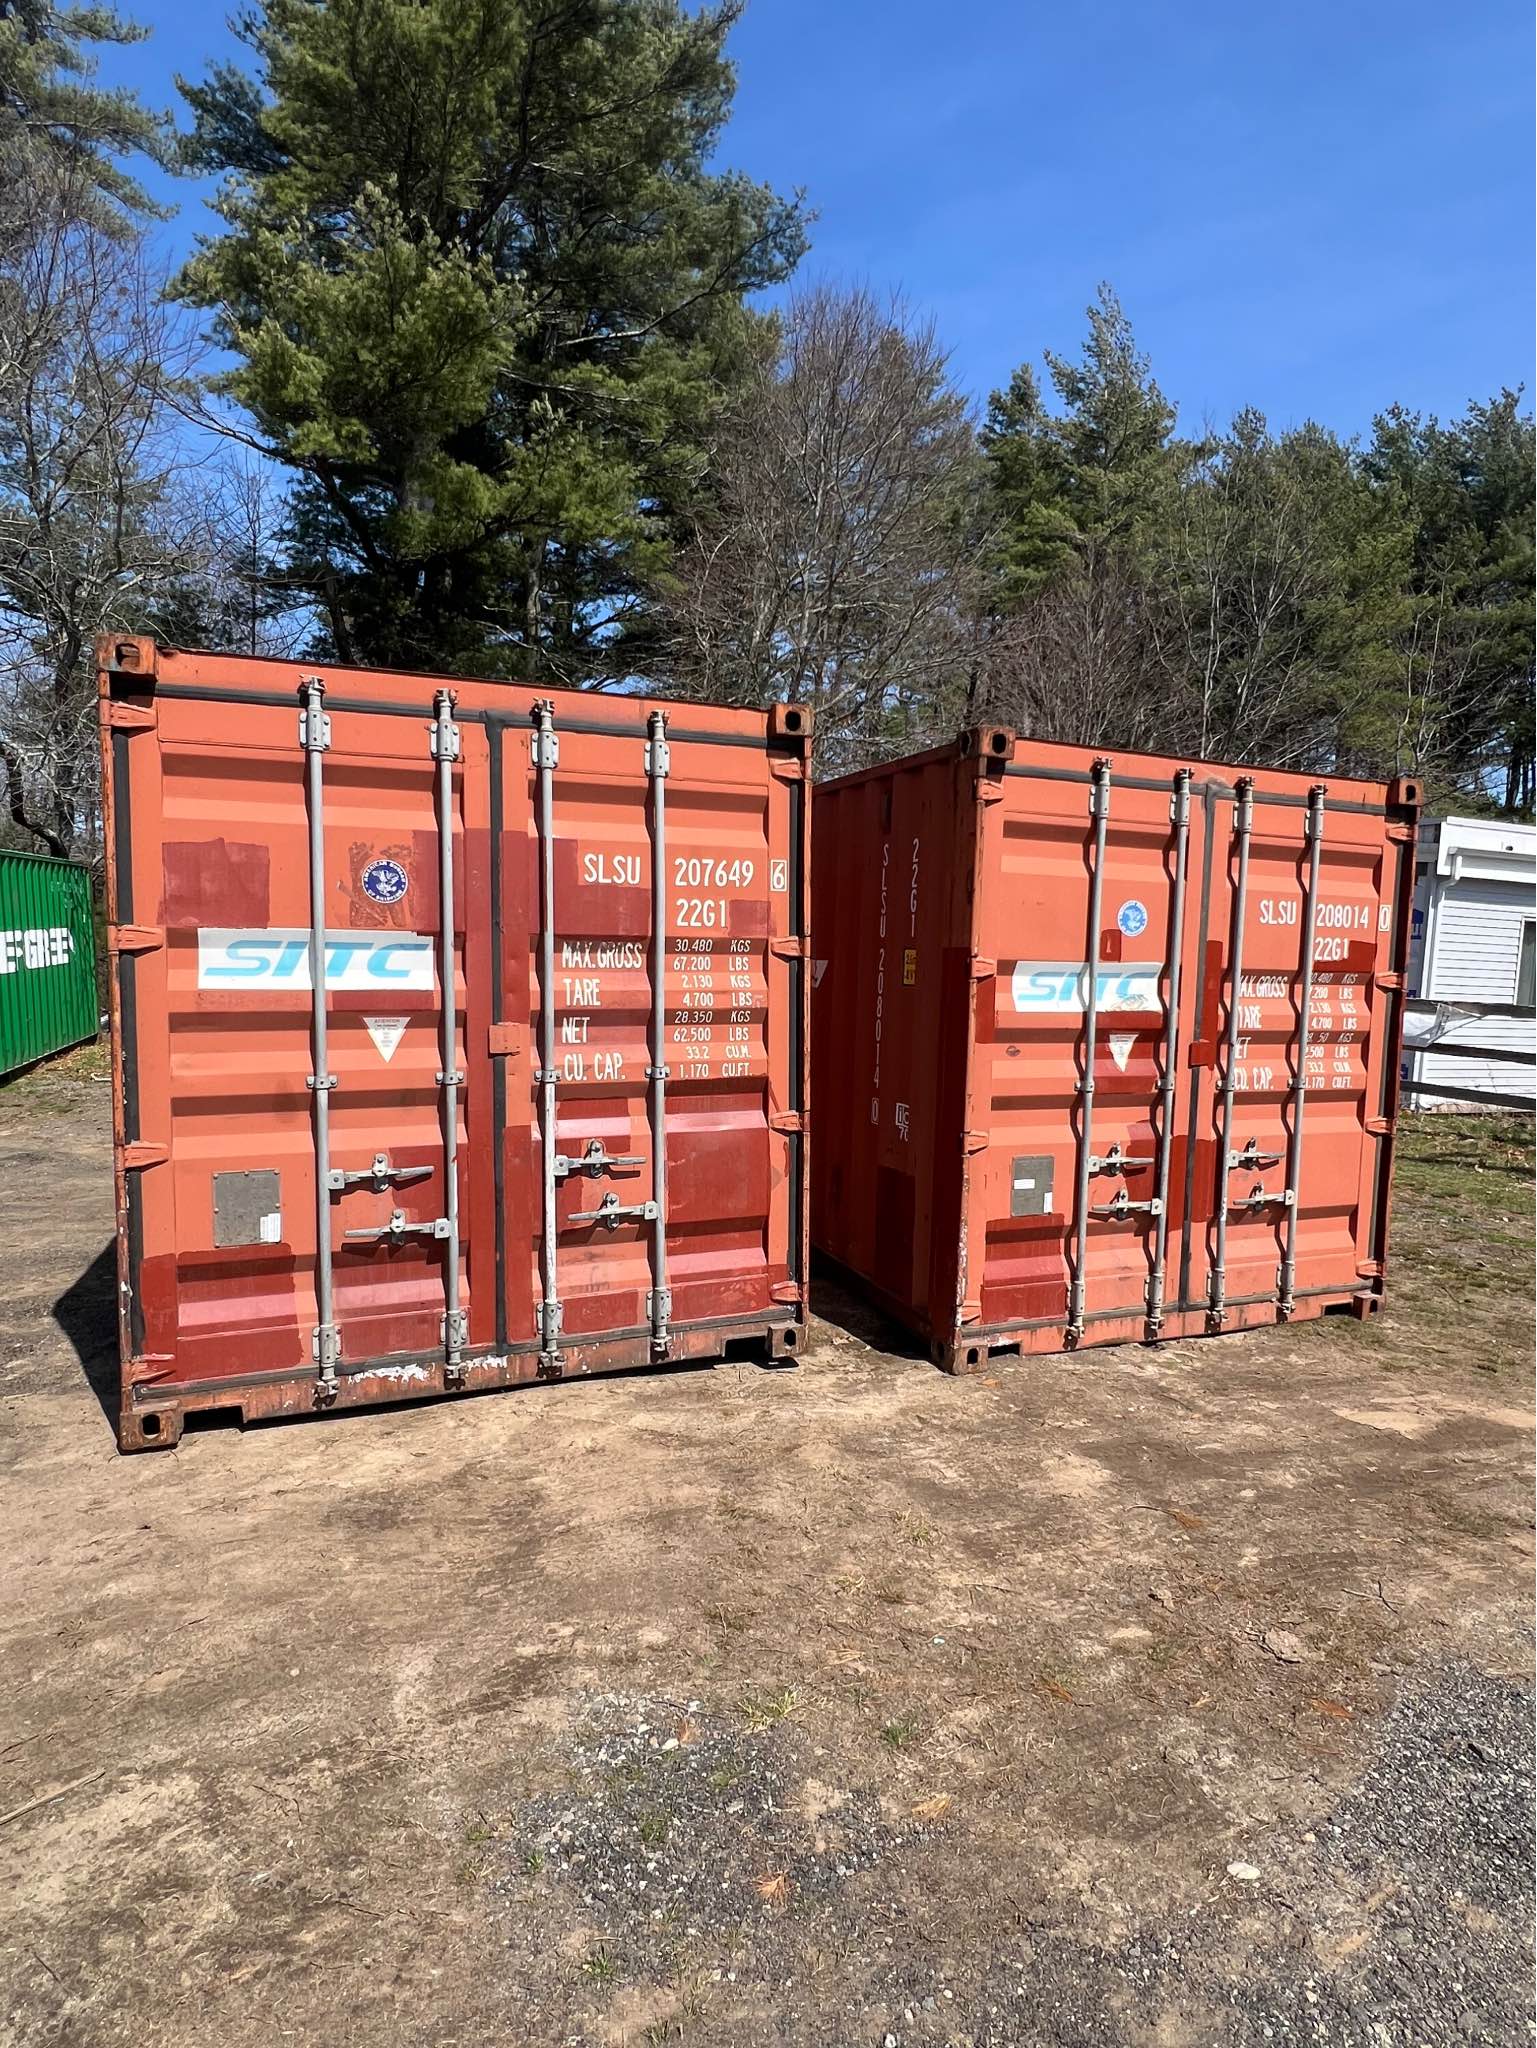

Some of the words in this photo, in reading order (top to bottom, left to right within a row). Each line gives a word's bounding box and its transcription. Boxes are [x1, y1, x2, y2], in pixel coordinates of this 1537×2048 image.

[583, 854, 641, 885] SLSU
[674, 858, 754, 887] 207649
[771, 861, 786, 890] 6
[880, 843, 889, 938] SLSU
[910, 838, 919, 938] 22G1
[676, 899, 727, 928] 22G1
[1259, 900, 1297, 925] SLSU
[1316, 903, 1369, 929] 208014
[1380, 906, 1390, 930] 0
[675, 939, 713, 953] 30.480
[730, 939, 751, 952] KGS
[1314, 937, 1349, 961] 22G1
[204, 940, 430, 978] SITC
[673, 956, 711, 971] 67.200
[729, 956, 749, 971] LBS
[682, 975, 713, 988] 2.130
[731, 975, 751, 988] KGS
[1017, 971, 1159, 1001] SITC
[1239, 976, 1288, 998] AX.GROSS
[1311, 973, 1333, 984] 0.480
[563, 978, 600, 1006] TARE
[683, 992, 713, 1007] 4.700
[732, 992, 752, 1007] LBS
[1339, 987, 1353, 999] LBS
[675, 1011, 713, 1023] 28.350
[730, 1011, 751, 1023] KGS
[874, 948, 885, 1088] 208014
[1238, 1005, 1262, 1028] TARE
[1312, 1018, 1333, 1029] 4.700
[1343, 1018, 1357, 1029] LBS
[562, 1017, 591, 1043] NET
[673, 1028, 711, 1042] 62.500
[729, 1028, 749, 1041] LBS
[687, 1046, 710, 1059] 33.2
[1335, 1046, 1349, 1058] LBS
[564, 1054, 588, 1081] CU.
[594, 1053, 625, 1080] CAP.
[680, 1064, 709, 1079] 1.170
[1253, 1066, 1274, 1089] CAP.
